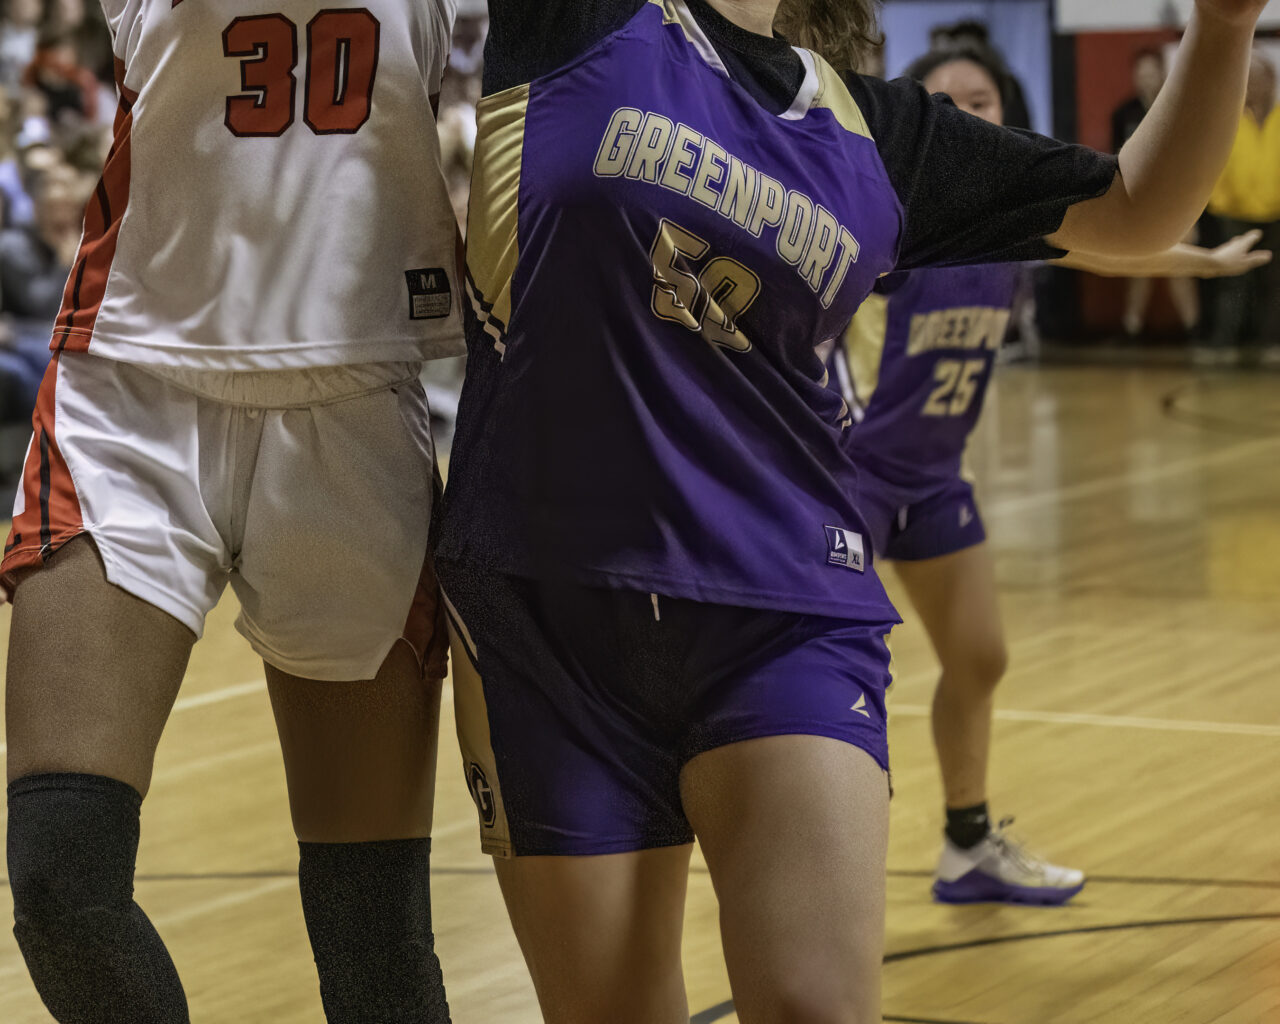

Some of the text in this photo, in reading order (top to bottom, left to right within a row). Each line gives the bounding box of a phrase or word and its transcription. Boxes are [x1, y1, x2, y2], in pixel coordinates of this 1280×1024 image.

[221, 7, 381, 137] 30
[592, 106, 861, 310] GREENPORT
[920, 358, 987, 416] 25
